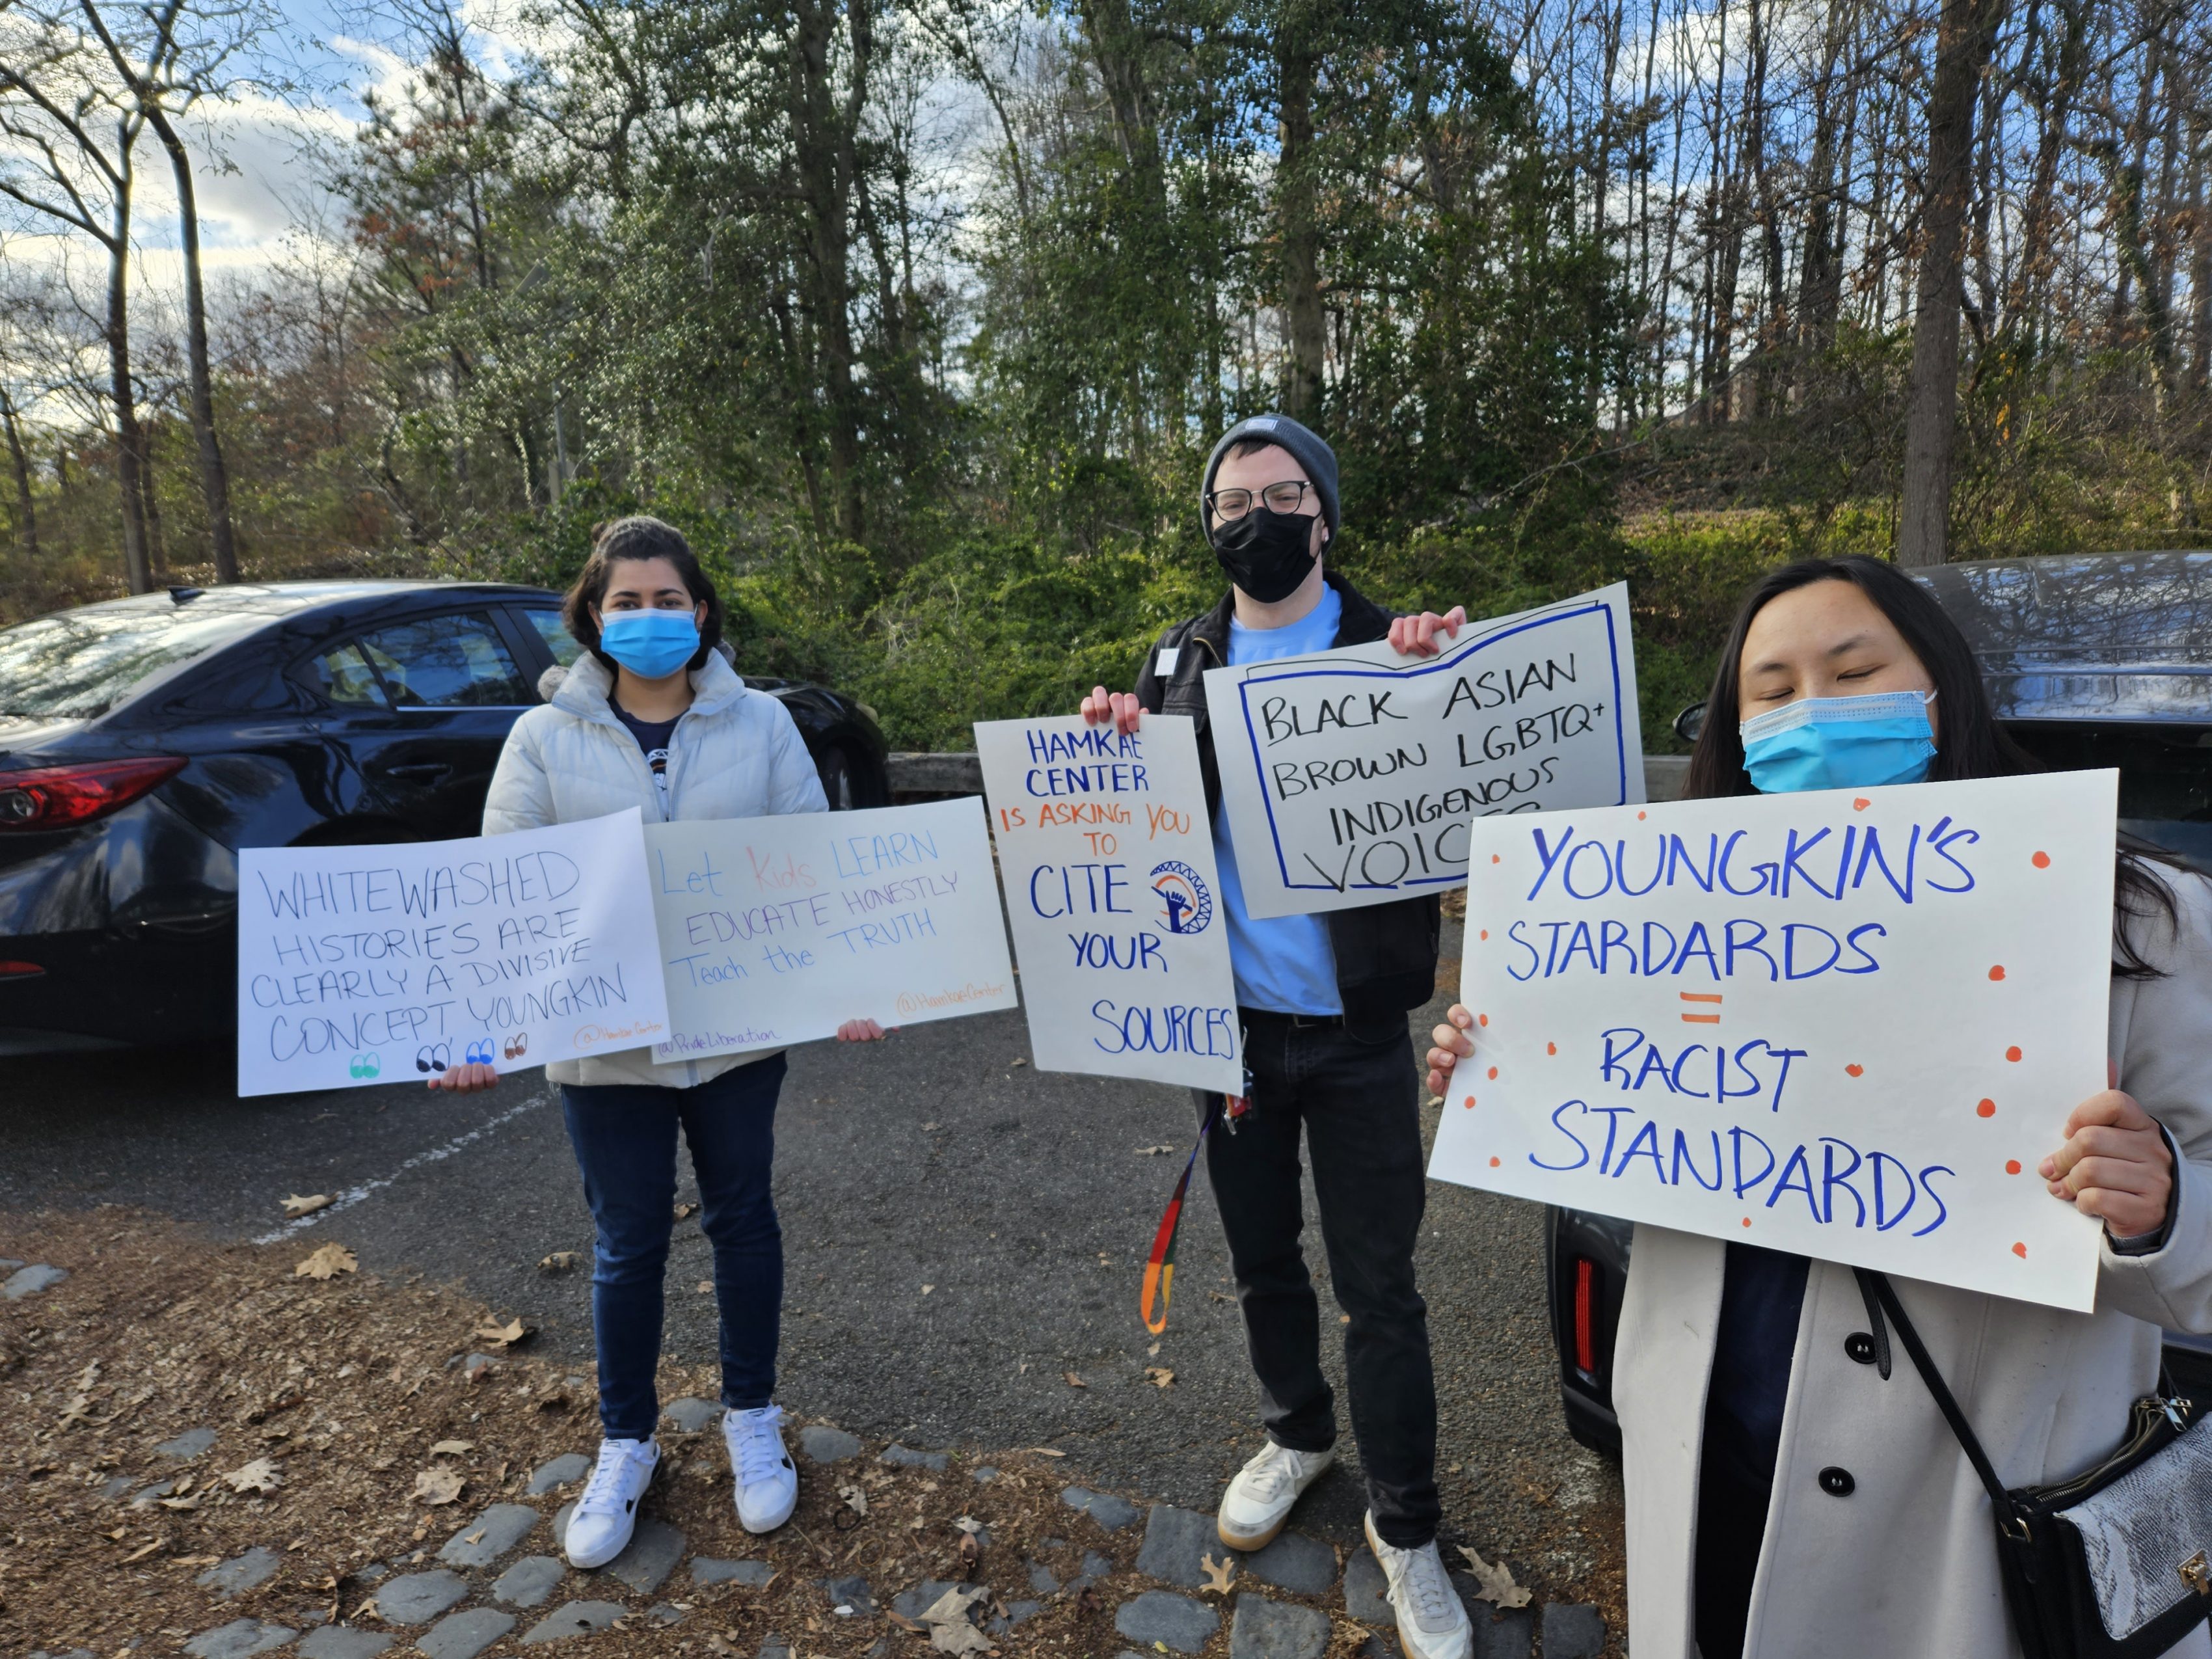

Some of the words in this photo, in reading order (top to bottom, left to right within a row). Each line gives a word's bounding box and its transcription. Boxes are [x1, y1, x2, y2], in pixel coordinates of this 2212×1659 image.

[1261, 691, 1408, 747] BLACK
[1442, 653, 1576, 720] ASIAN
[1026, 764, 1149, 798] CENTER
[1027, 729, 1143, 764] HAMKAE
[1273, 743, 1427, 801] BROWN
[1457, 702, 1605, 768] LGBTQ+
[1001, 807, 1026, 831] IS
[1039, 803, 1131, 828] ASKING
[1146, 803, 1191, 841] YOU
[1329, 757, 1559, 846] INDIGENOUS
[658, 848, 723, 897] Let
[831, 830, 939, 879] LEARN
[1083, 832, 1117, 856] TO
[1302, 802, 1541, 893] VOIC
[1526, 816, 1979, 904] YOUNGKIN'S
[258, 850, 580, 919] WHITEWASHED
[686, 891, 831, 945] EDUCATE
[841, 870, 958, 915] HONESTLY
[1030, 864, 1133, 919] CITE
[273, 922, 479, 965] HISTORIES
[498, 908, 581, 950] ARE
[668, 952, 748, 988] Teach
[763, 945, 815, 973] the
[826, 908, 937, 954] TRUTH
[1068, 932, 1168, 973] YOUR
[1507, 918, 1887, 982] STARDARDS
[251, 968, 407, 1008] CLEARLY
[425, 964, 454, 995] A
[461, 937, 591, 988] DIVISIVE
[466, 962, 627, 1031] YOUNGKIN
[1092, 999, 1234, 1060] SOURCES
[1601, 1027, 1807, 1113] RACIST
[1528, 1099, 1956, 1237] STANDARDS
